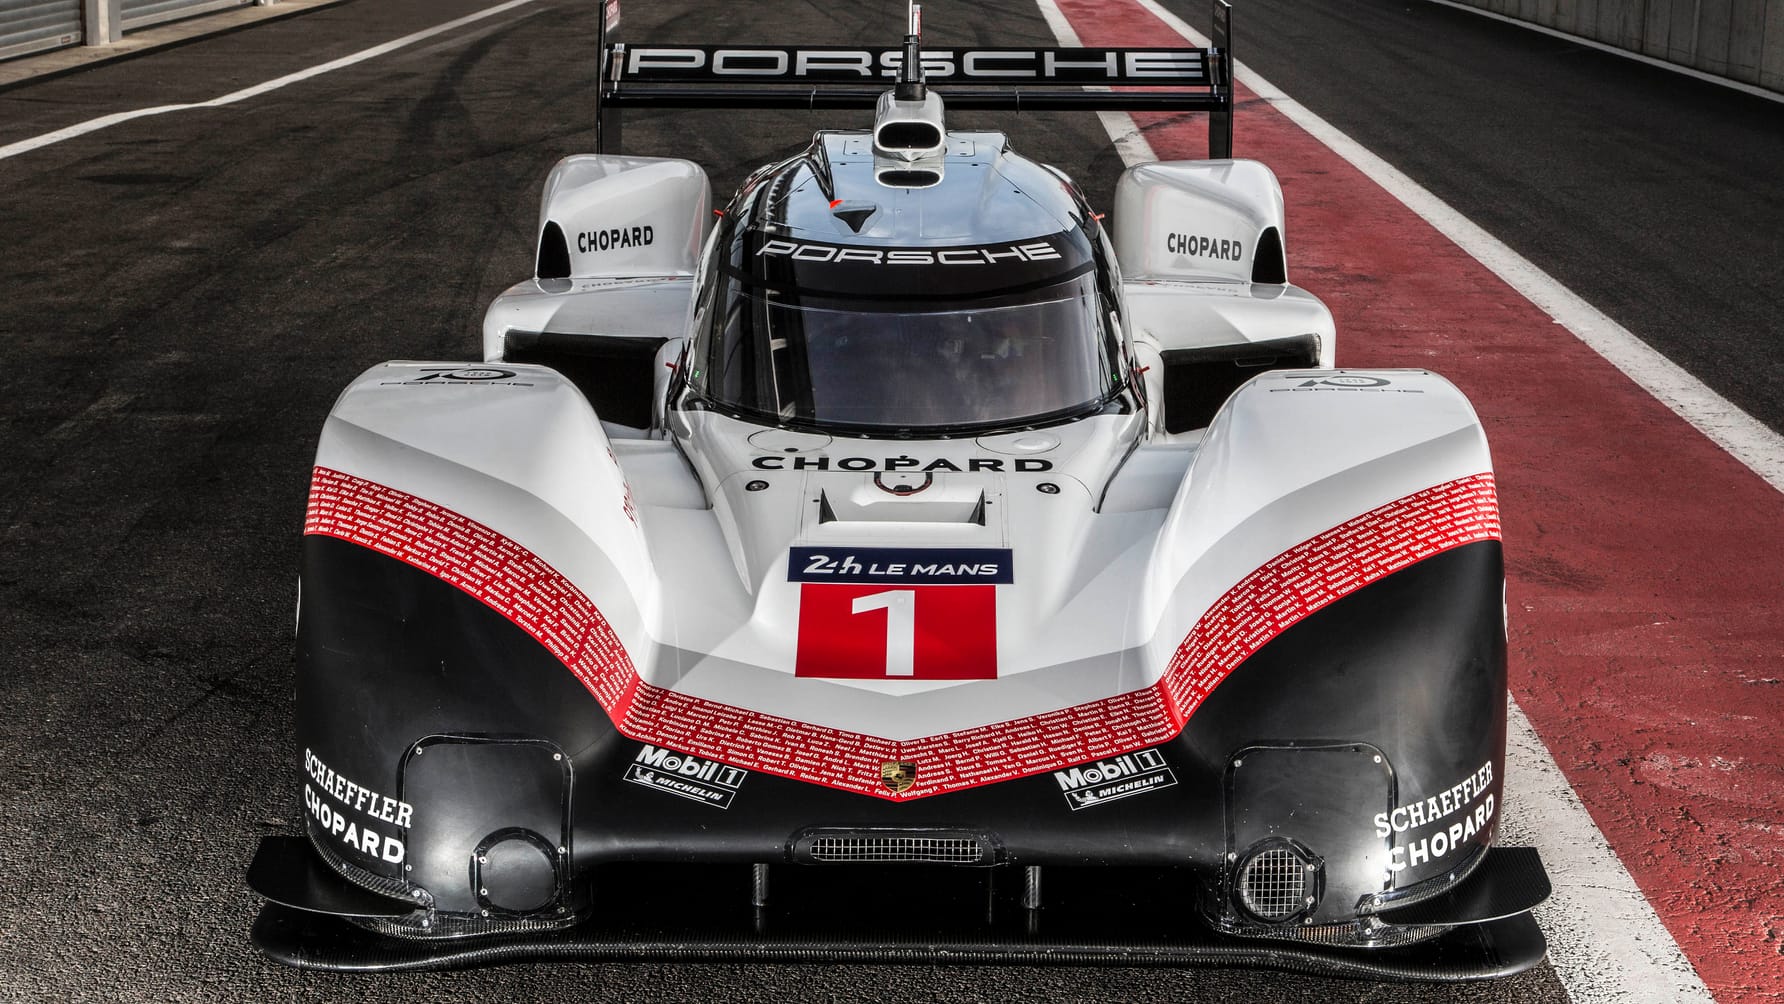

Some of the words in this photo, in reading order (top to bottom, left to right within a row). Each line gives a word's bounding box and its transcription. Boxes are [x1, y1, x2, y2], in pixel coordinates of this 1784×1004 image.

[628, 49, 1203, 77] PORSCHE
[577, 225, 654, 253] CHOPARD
[755, 239, 1062, 265] PORSCHE
[1167, 232, 1242, 261] CHOPARD
[751, 456, 1053, 472] CHOPARD
[868, 563, 906, 576] LE
[910, 563, 999, 577] MANS
[851, 589, 916, 676] 1
[635, 745, 718, 781] Mobil
[726, 768, 739, 786] 1
[1054, 755, 1138, 791] Mobil
[1142, 752, 1157, 766] 1
[305, 747, 414, 829] SCHAEFFLER
[656, 777, 724, 800] MICHELIN
[831, 779, 864, 790] Alexander
[1099, 775, 1164, 797] MICHELIN
[1374, 760, 1493, 839] SCHAEFFLER
[305, 783, 405, 864] CHOPARD
[1387, 793, 1495, 872] CHOPARD
